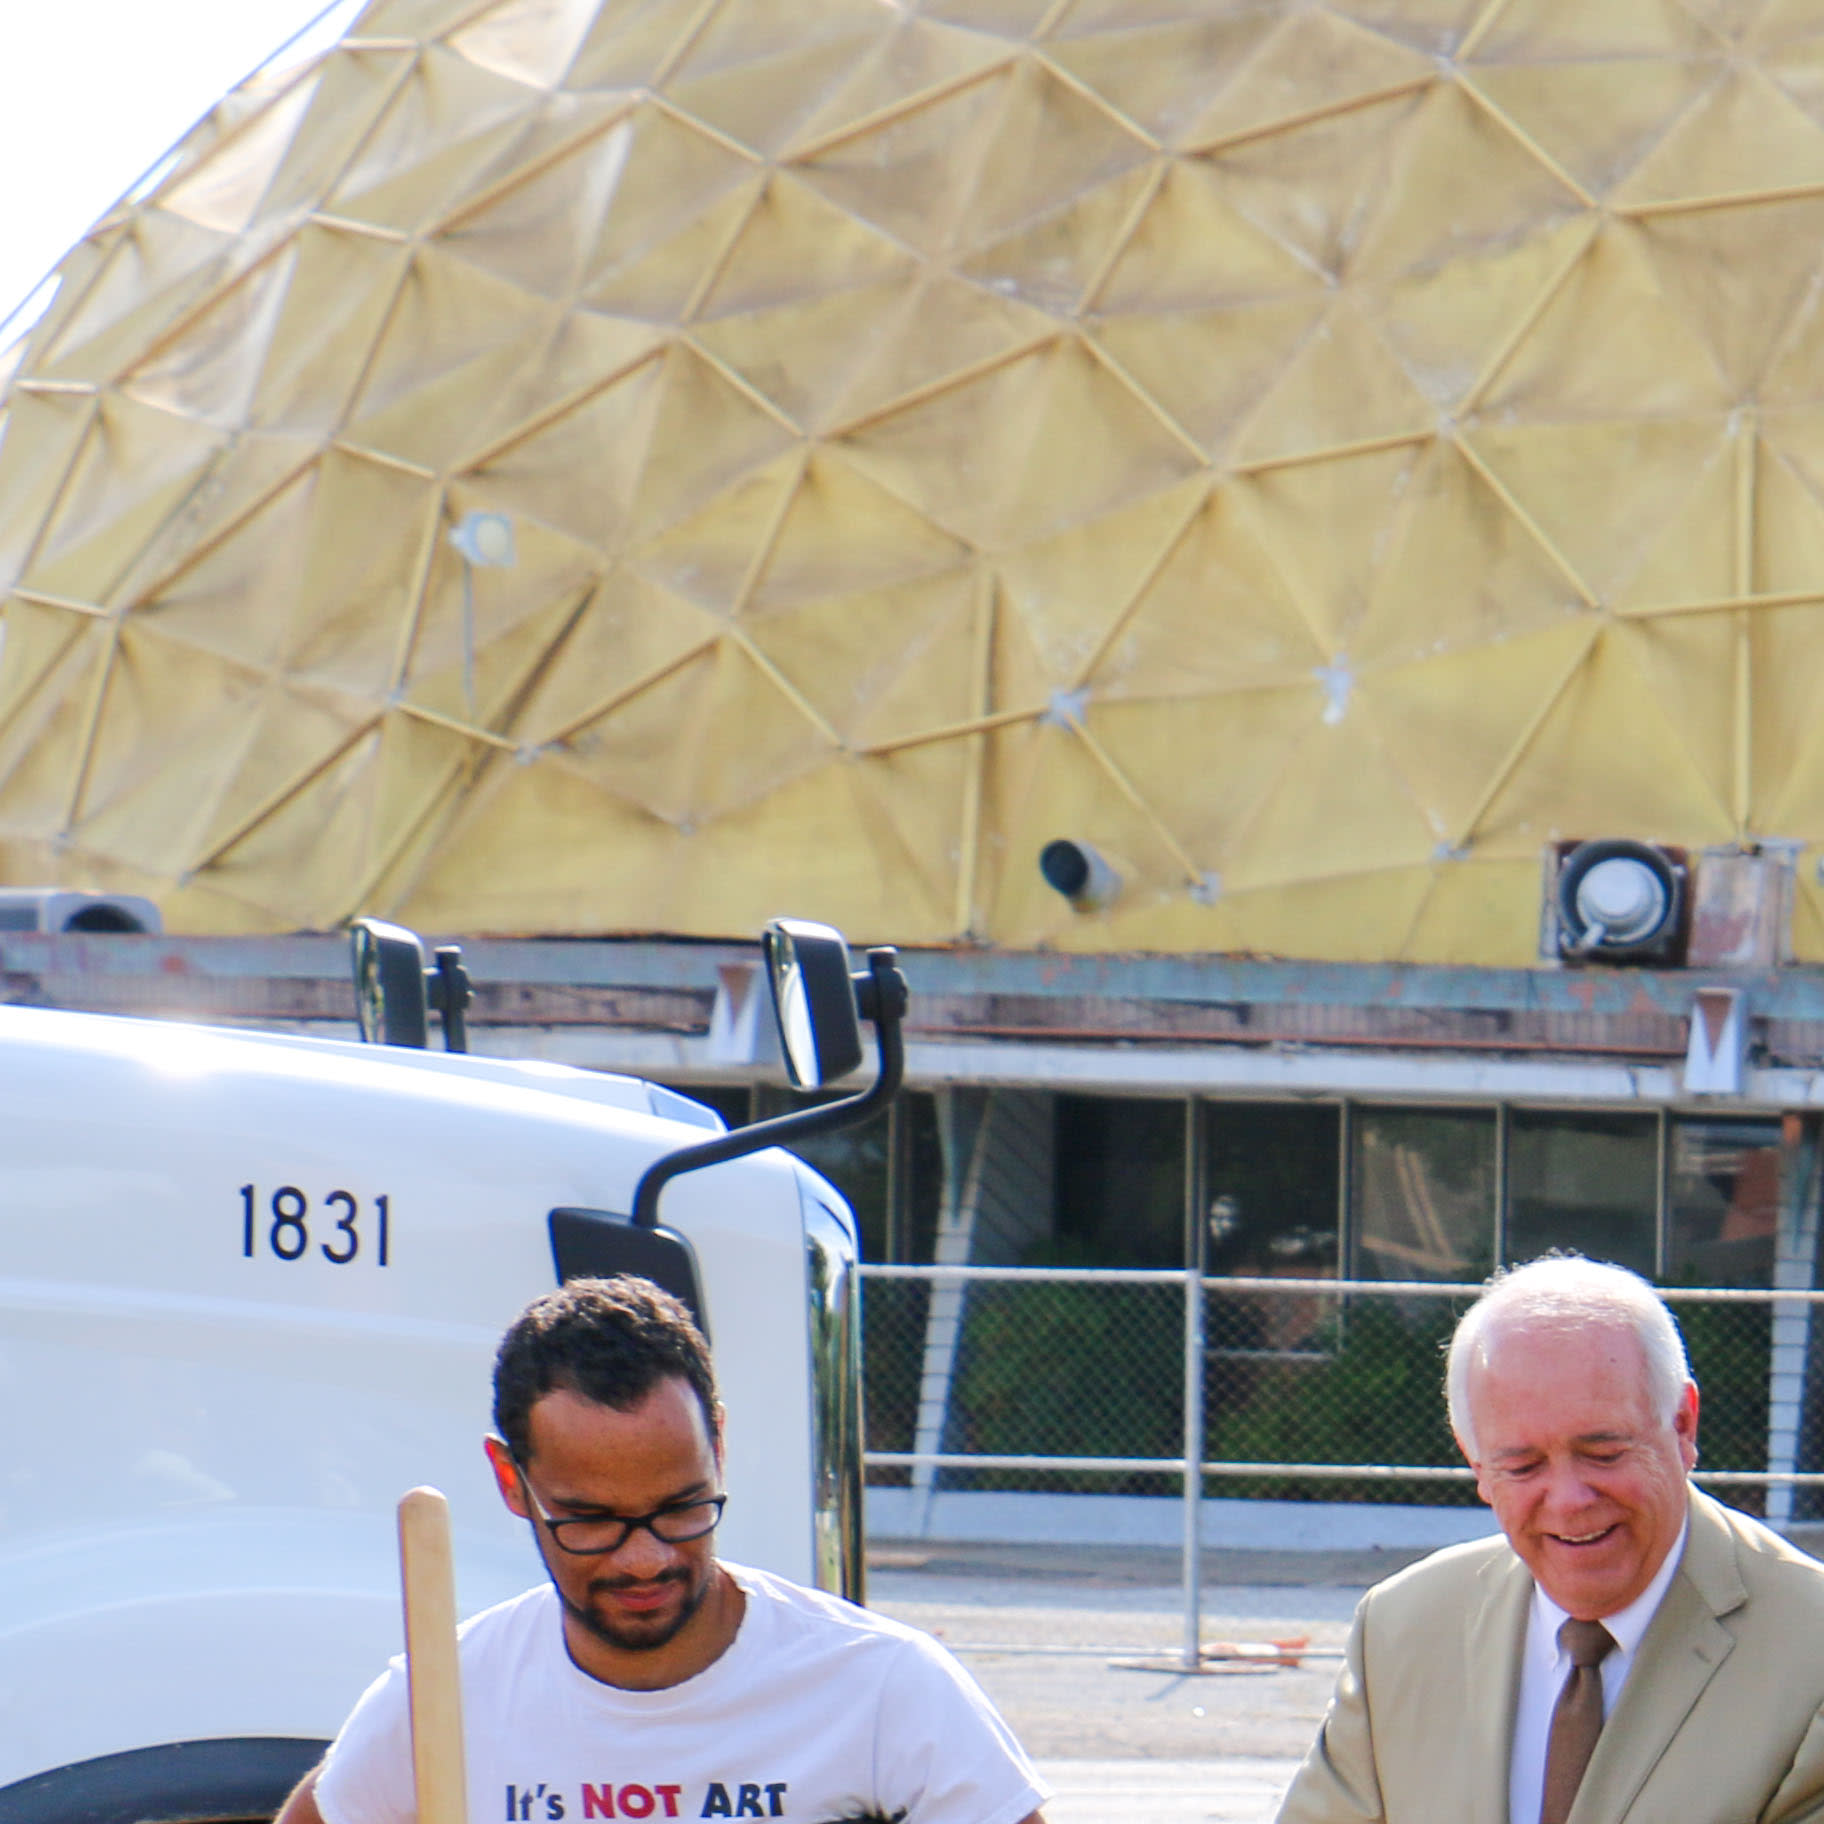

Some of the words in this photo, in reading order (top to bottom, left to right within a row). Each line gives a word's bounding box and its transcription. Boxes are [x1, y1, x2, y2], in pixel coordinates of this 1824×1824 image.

[240, 1184, 388, 1267] 1831
[506, 1783, 565, 1822] It's
[582, 1783, 682, 1820] NOT
[700, 1782, 788, 1819] ART
